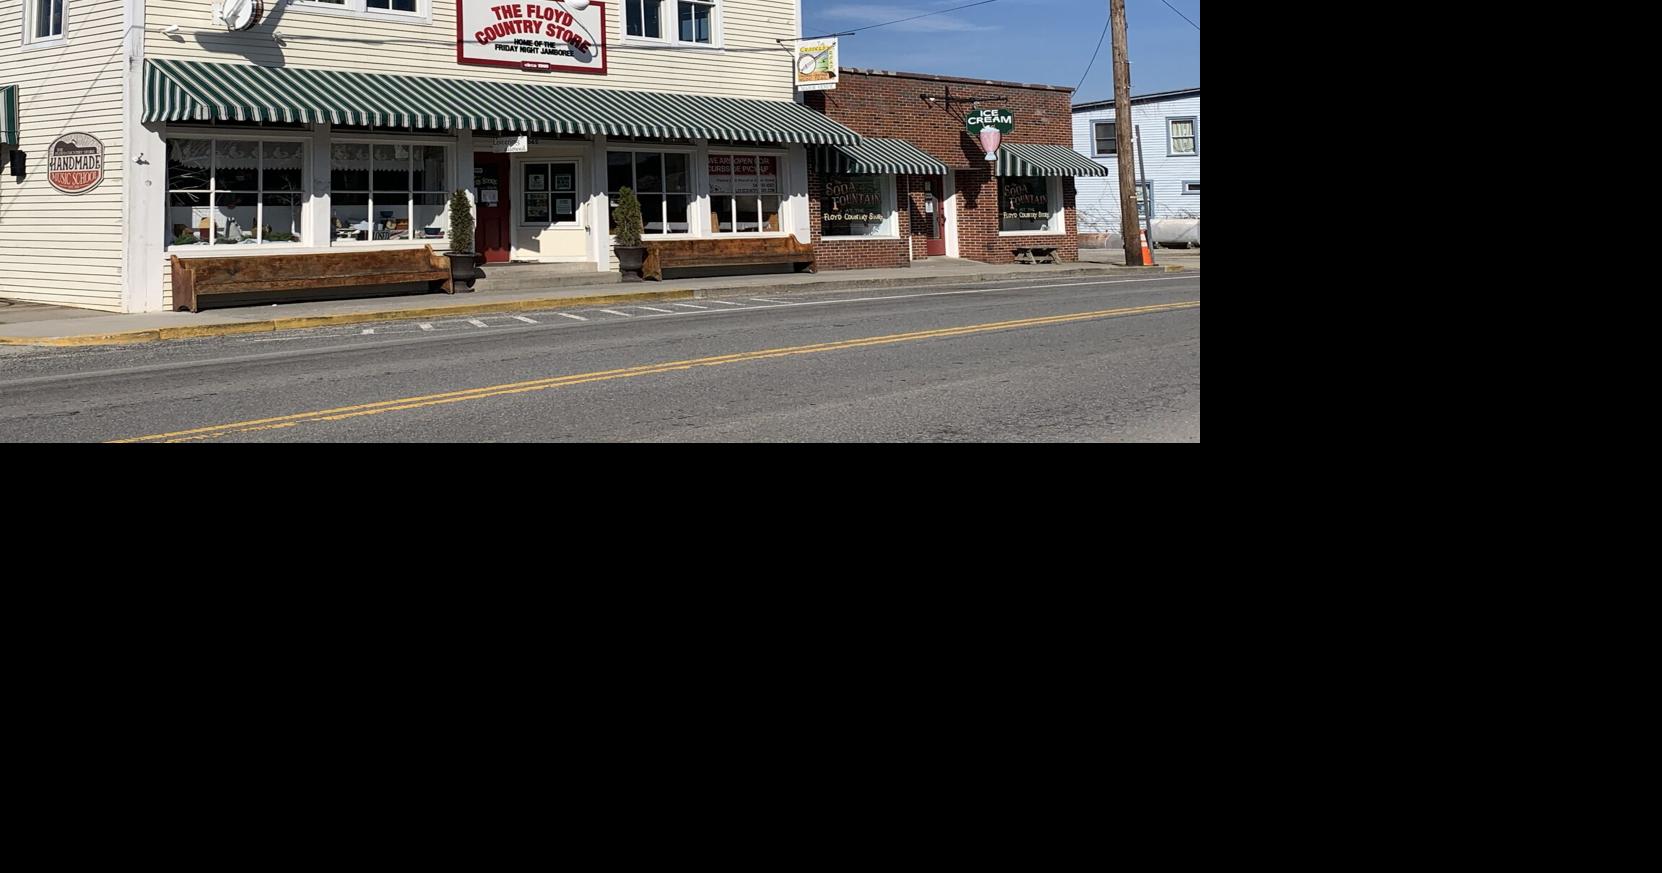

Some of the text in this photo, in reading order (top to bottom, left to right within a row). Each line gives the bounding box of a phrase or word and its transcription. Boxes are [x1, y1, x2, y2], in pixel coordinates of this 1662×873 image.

[491, 4, 574, 27] THE FLOYD
[475, 19, 591, 53] COUNTRY STORE
[495, 44, 574, 56] FRIDAY NIGHT JAMBOREE
[968, 115, 1012, 125] CREAM
[50, 155, 100, 170] HANDMADE
[52, 171, 97, 185] MUSIC SCHOOL
[825, 182, 856, 196] SODA
[1005, 184, 1028, 197] SODA
[832, 193, 881, 210] FOUNTAIN
